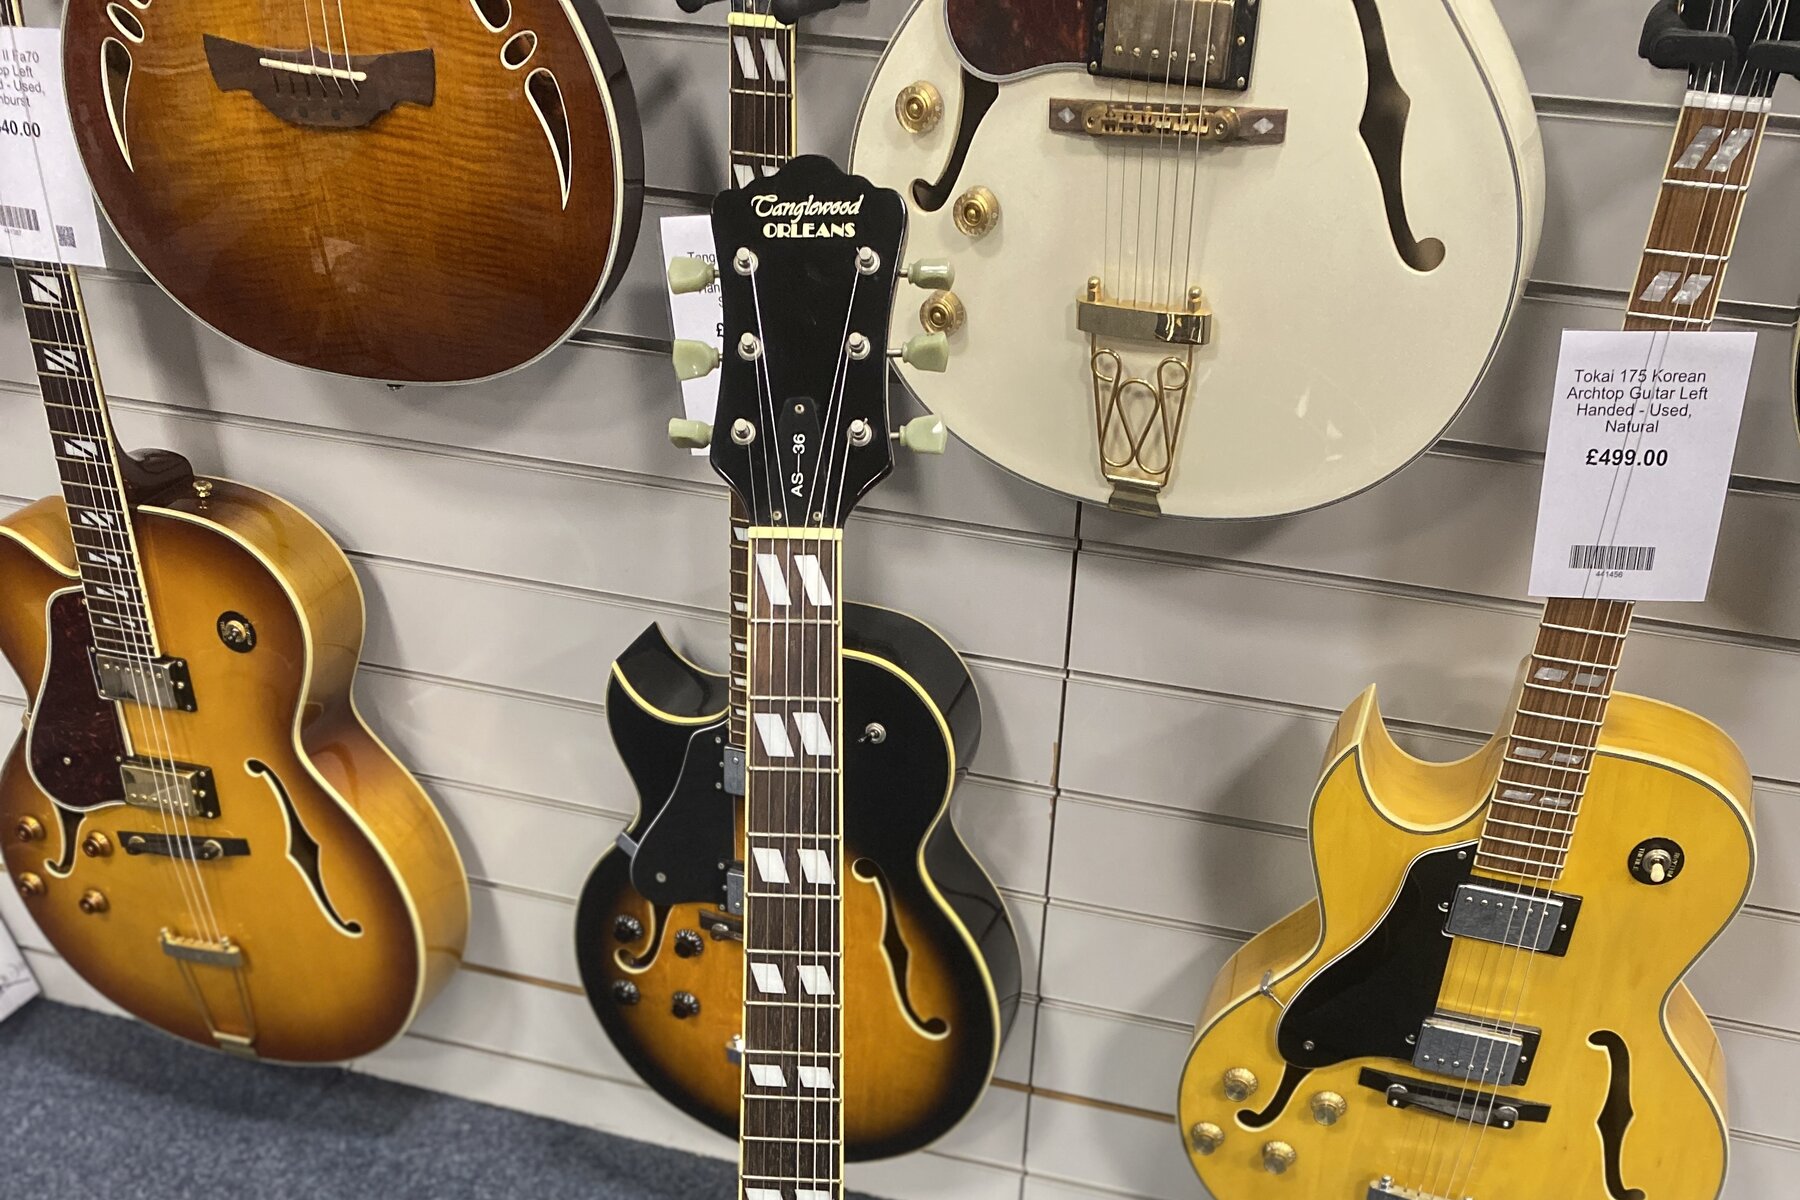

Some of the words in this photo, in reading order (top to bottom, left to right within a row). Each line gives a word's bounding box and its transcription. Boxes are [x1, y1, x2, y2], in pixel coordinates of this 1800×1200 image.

[12, 64, 33, 78] Left
[13, 79, 46, 96] Used,
[0, 118, 41, 138] 40.00
[750, 193, 865, 224] Tanglewood
[762, 221, 856, 239] ORLEANS
[1574, 368, 1615, 383] Tokai
[1619, 369, 1647, 383] 175
[1651, 369, 1706, 384] Korean
[1566, 386, 1624, 402] Archtop
[1679, 386, 1708, 400] Left
[1576, 403, 1635, 417] Handed
[1649, 403, 1692, 419] Used,
[1605, 420, 1659, 433] Natural
[1585, 448, 1668, 466] £499.00
